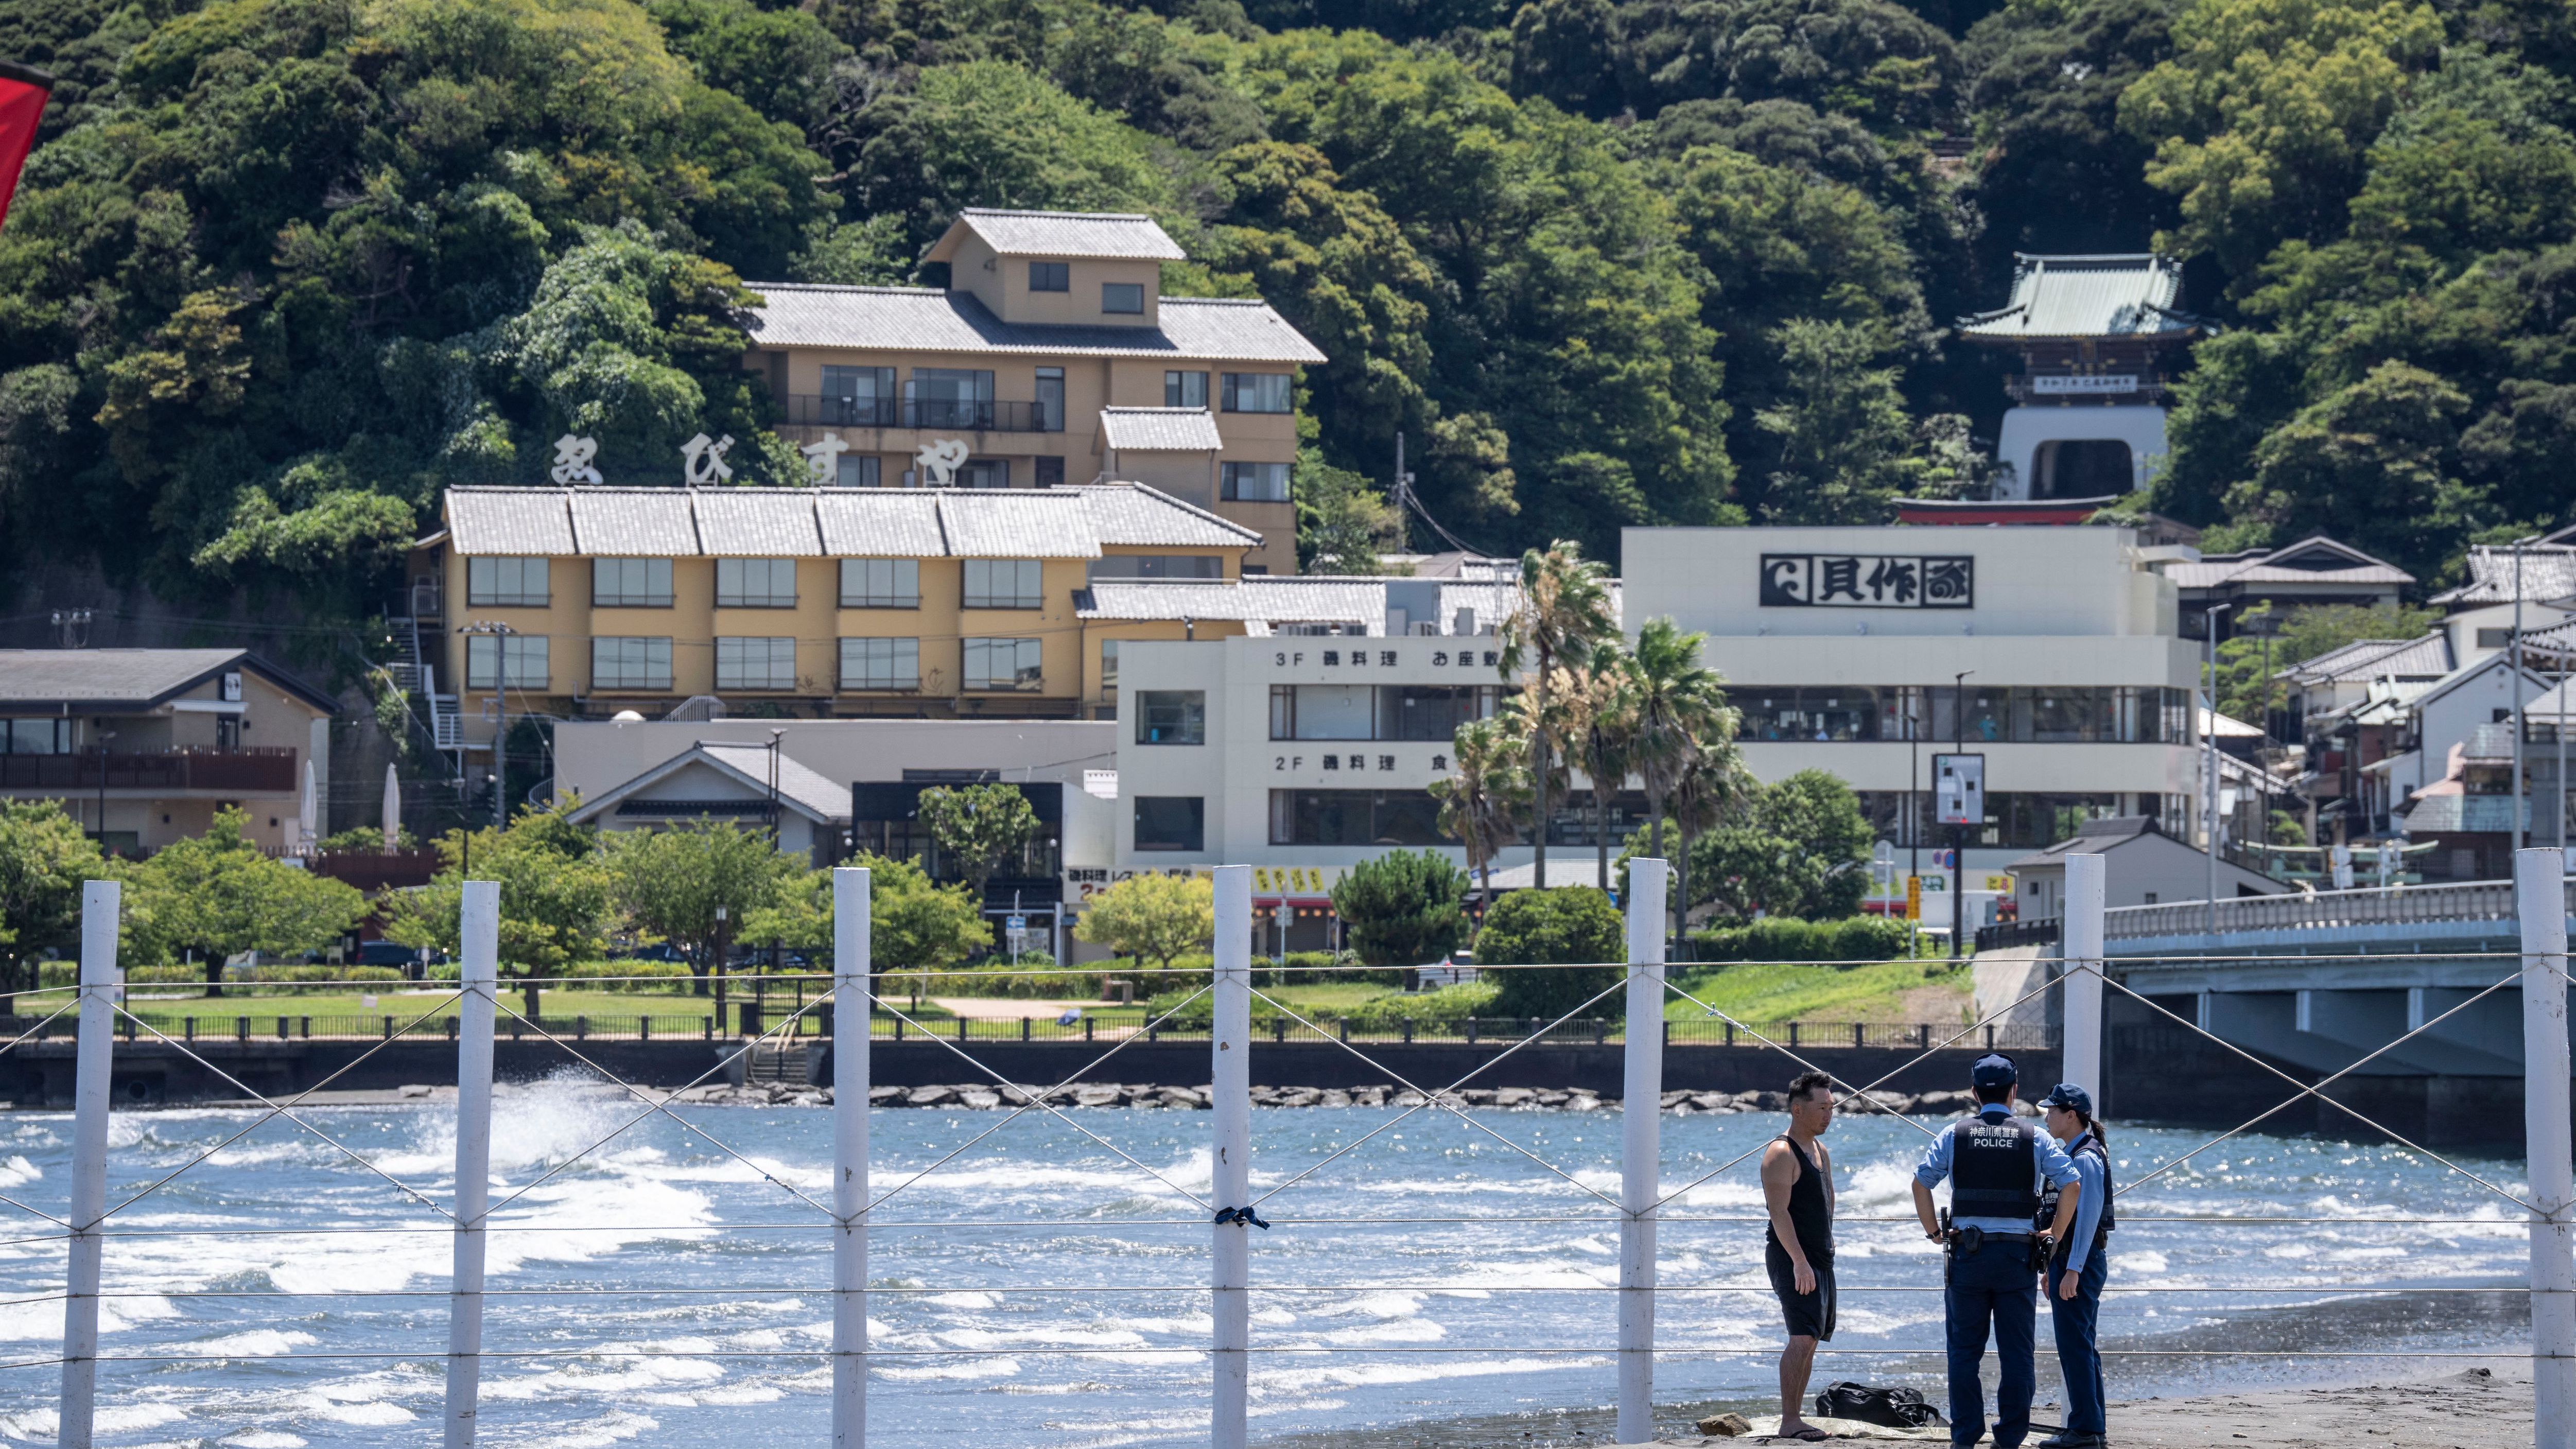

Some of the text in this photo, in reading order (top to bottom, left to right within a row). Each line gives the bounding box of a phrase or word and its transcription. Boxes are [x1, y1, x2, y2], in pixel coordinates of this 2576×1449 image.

[1819, 557, 1917, 603] 貝作
[1276, 652, 1303, 667] 3F
[1322, 650, 1398, 667] 磯料理
[1276, 756, 1302, 771] 2F
[1322, 754, 1396, 771] 磯料理
[1068, 868, 1107, 883] 磯料理
[1970, 1126, 2018, 1138] 神奈川県警察
[1974, 1138, 2013, 1148] POLICE
